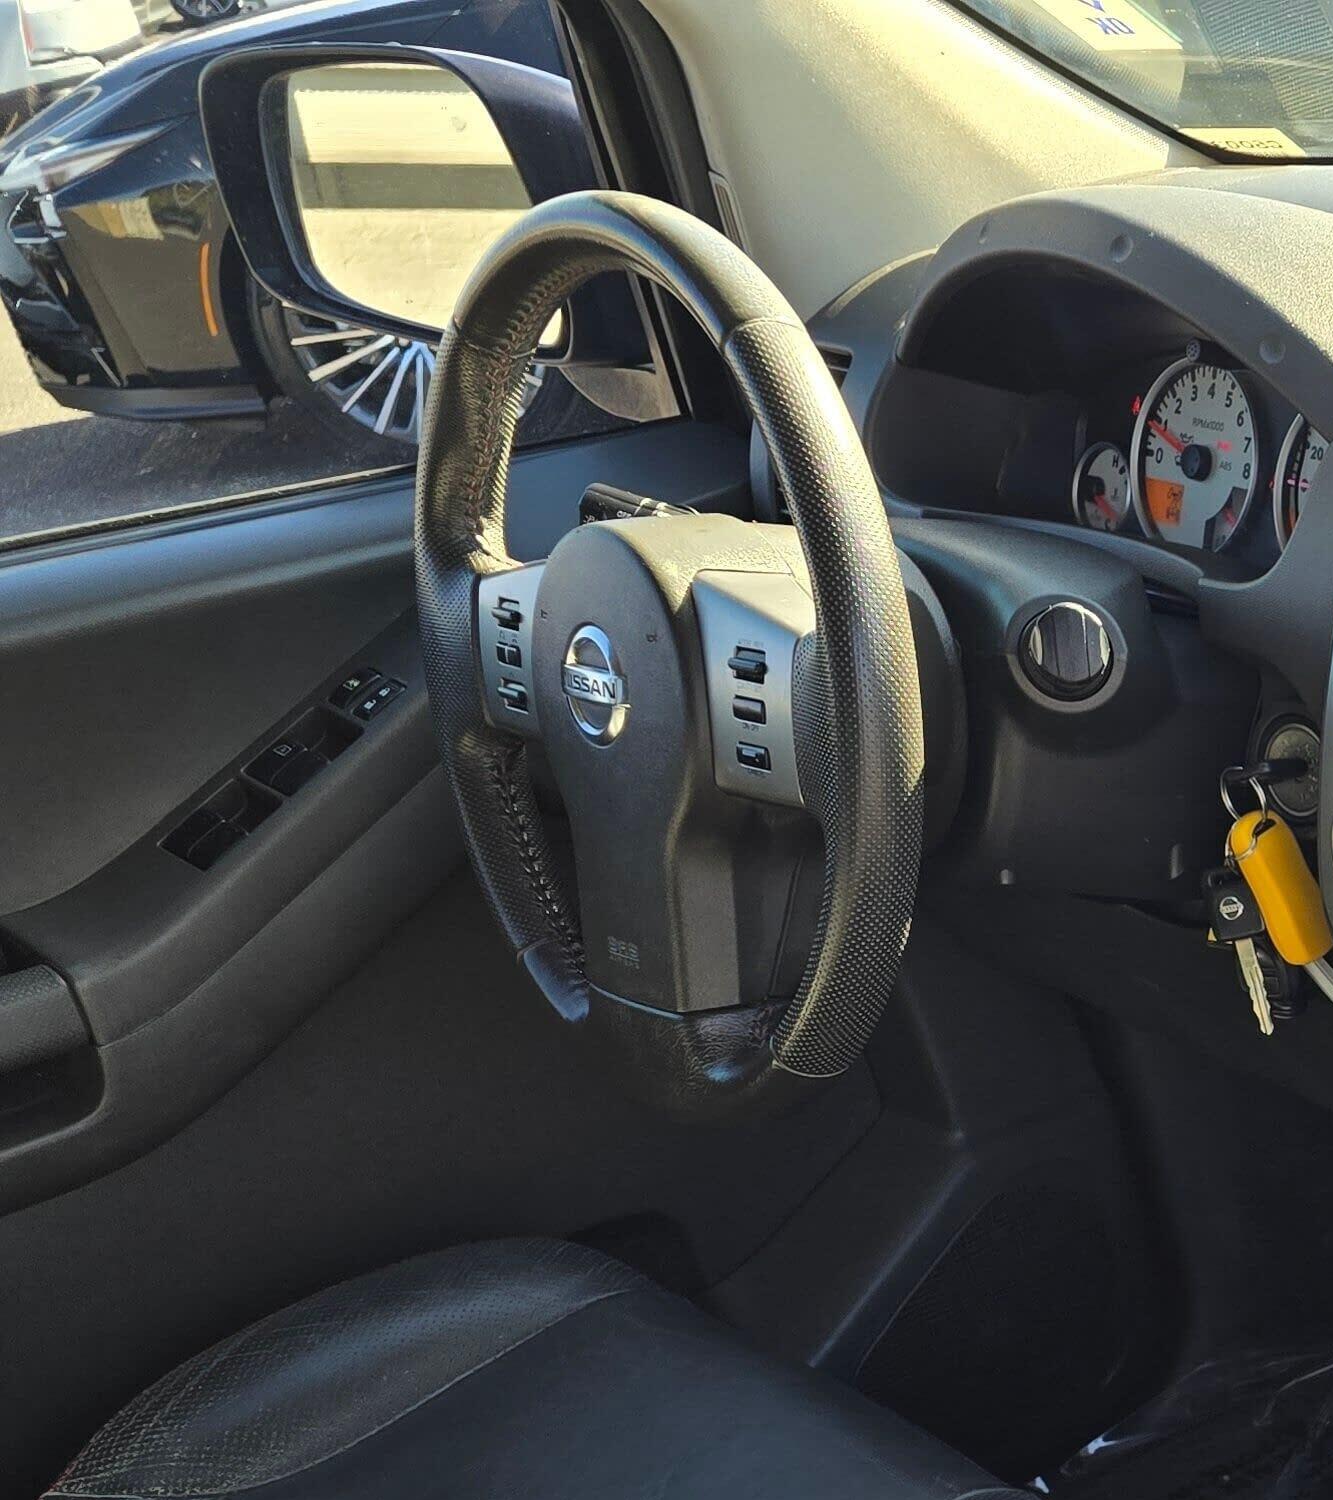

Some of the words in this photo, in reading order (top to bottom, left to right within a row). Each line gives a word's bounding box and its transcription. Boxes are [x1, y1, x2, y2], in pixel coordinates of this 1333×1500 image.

[1191, 385, 1198, 401] 3
[1208, 383, 1216, 399] 4
[1225, 391, 1233, 407] 5
[1175, 398, 1182, 415] 2
[1237, 411, 1244, 427] 6
[1244, 437, 1252, 453] 7
[1156, 448, 1163, 464] 0
[1242, 463, 1250, 479] 8
